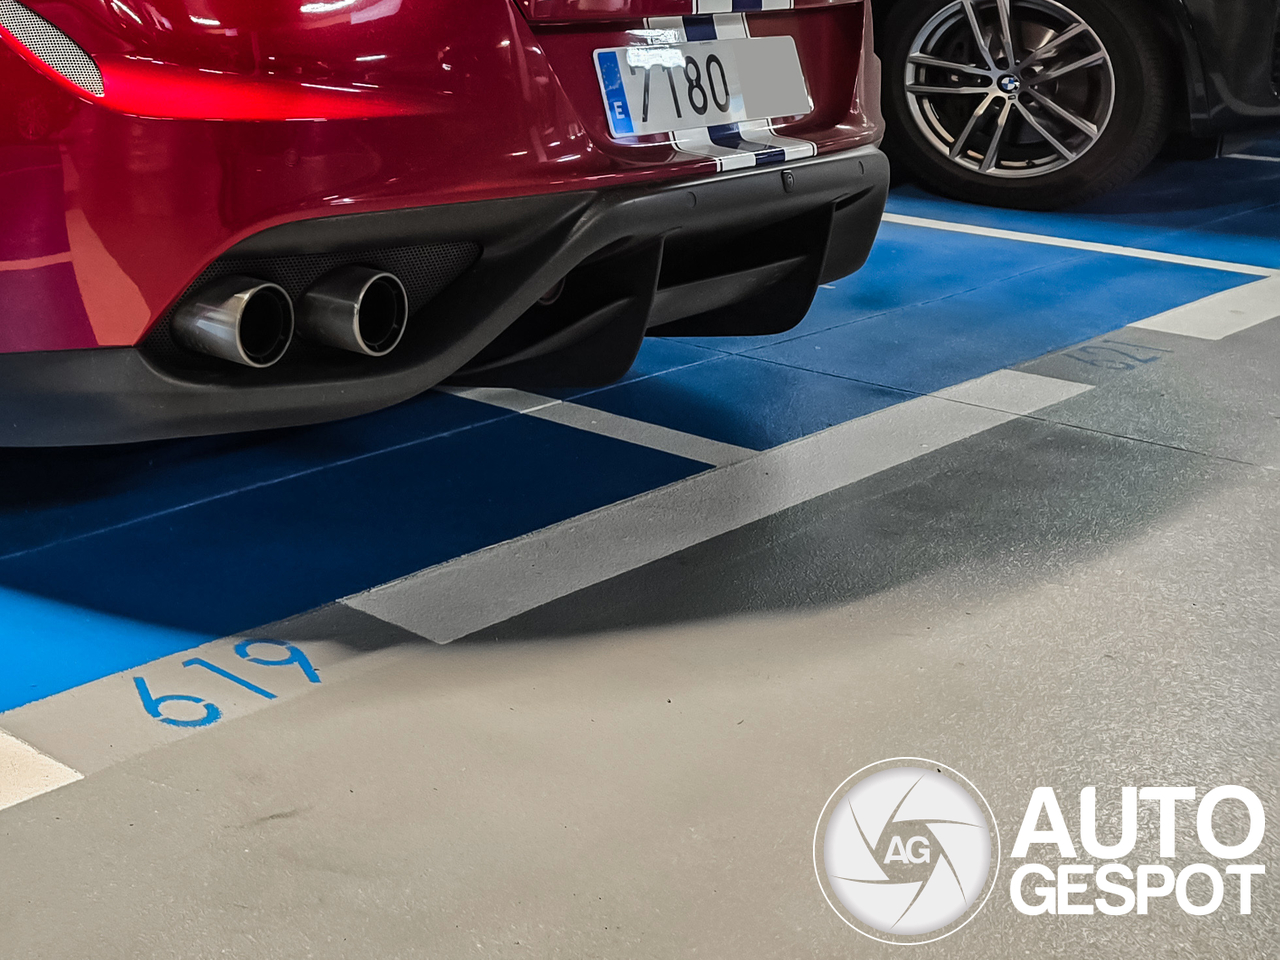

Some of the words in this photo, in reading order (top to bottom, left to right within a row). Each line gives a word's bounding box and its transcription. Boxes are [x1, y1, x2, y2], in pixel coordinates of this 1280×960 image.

[613, 101, 626, 119] E
[629, 53, 731, 123] 7180
[132, 638, 322, 728] 619
